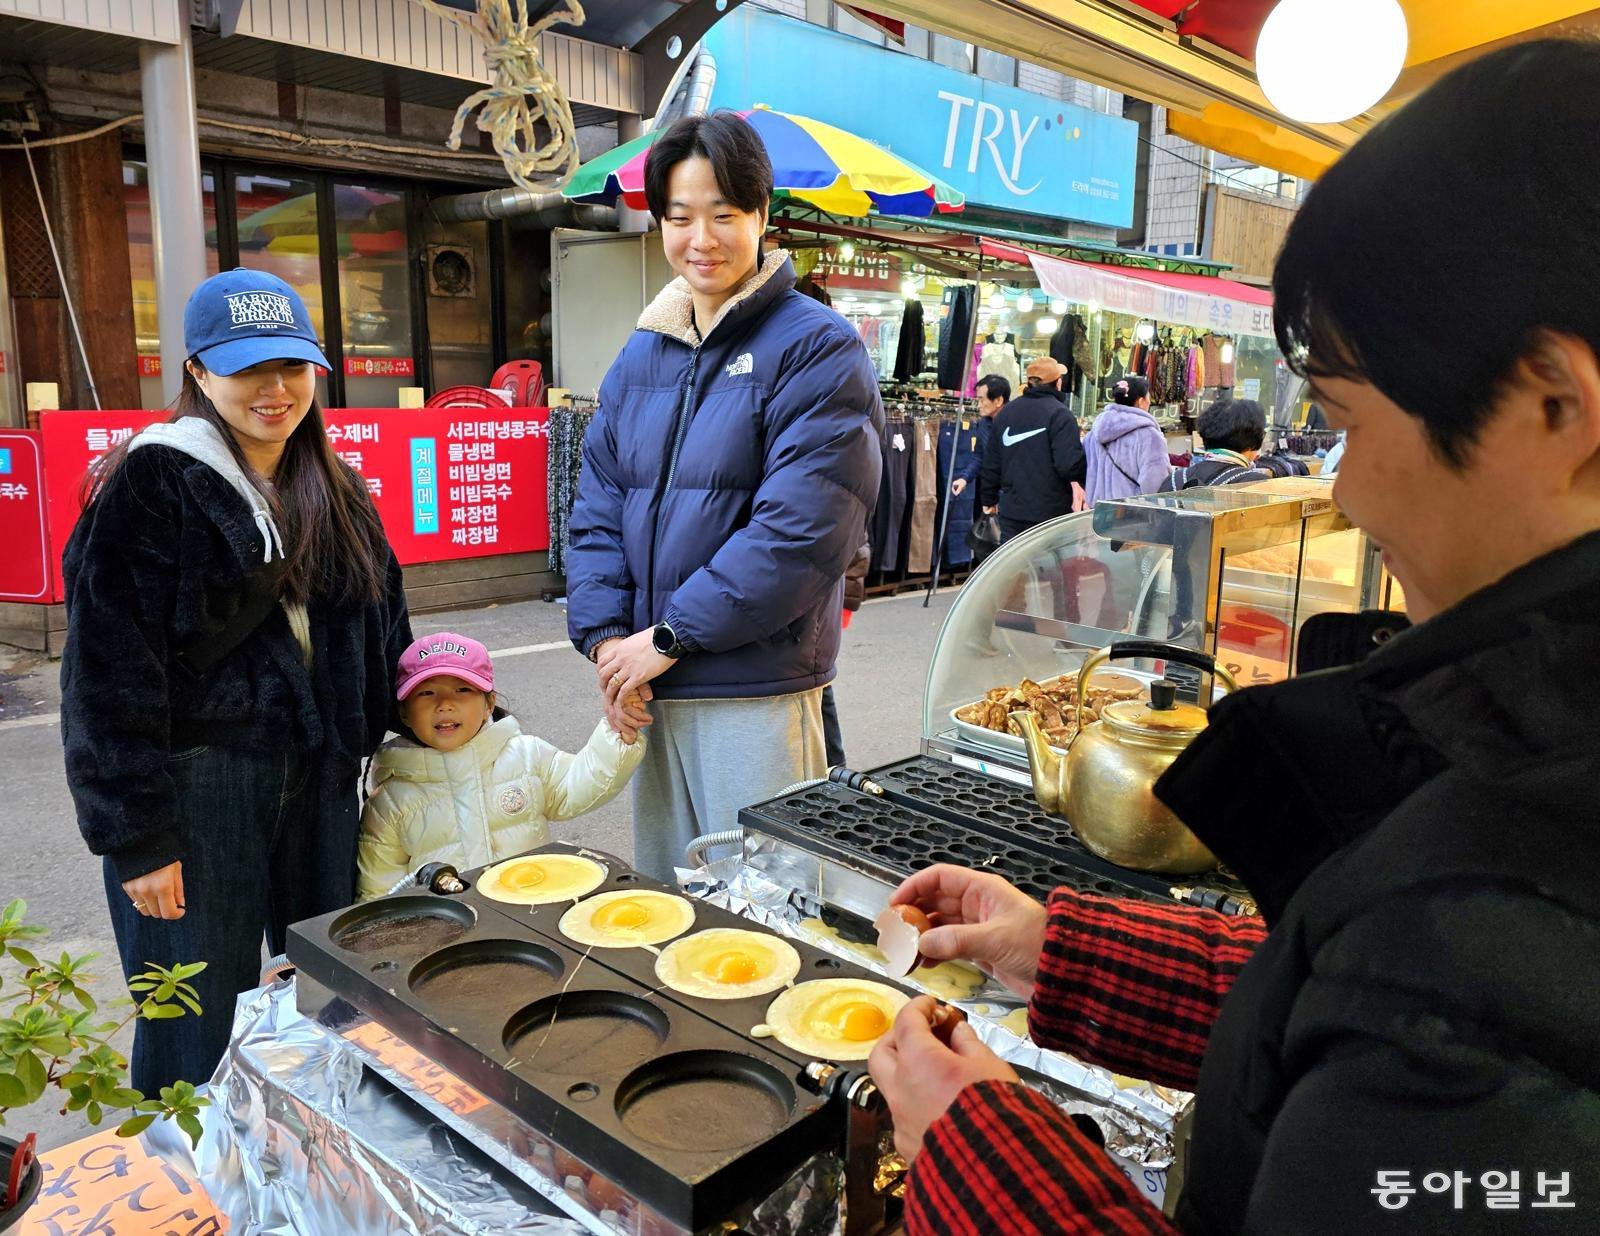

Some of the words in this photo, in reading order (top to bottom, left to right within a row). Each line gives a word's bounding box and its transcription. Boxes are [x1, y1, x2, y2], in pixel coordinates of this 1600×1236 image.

[937, 90, 1042, 196] TRY
[231, 310, 294, 324] GIRBAUD
[325, 423, 379, 444] 수제비
[448, 443, 496, 462] 물냉면
[449, 463, 512, 482] 비빔냉면
[415, 447, 434, 525] 계절메뉴
[450, 483, 513, 503] 비빔국수
[451, 504, 497, 524] 짜장면
[452, 525, 499, 546] 짜장밥
